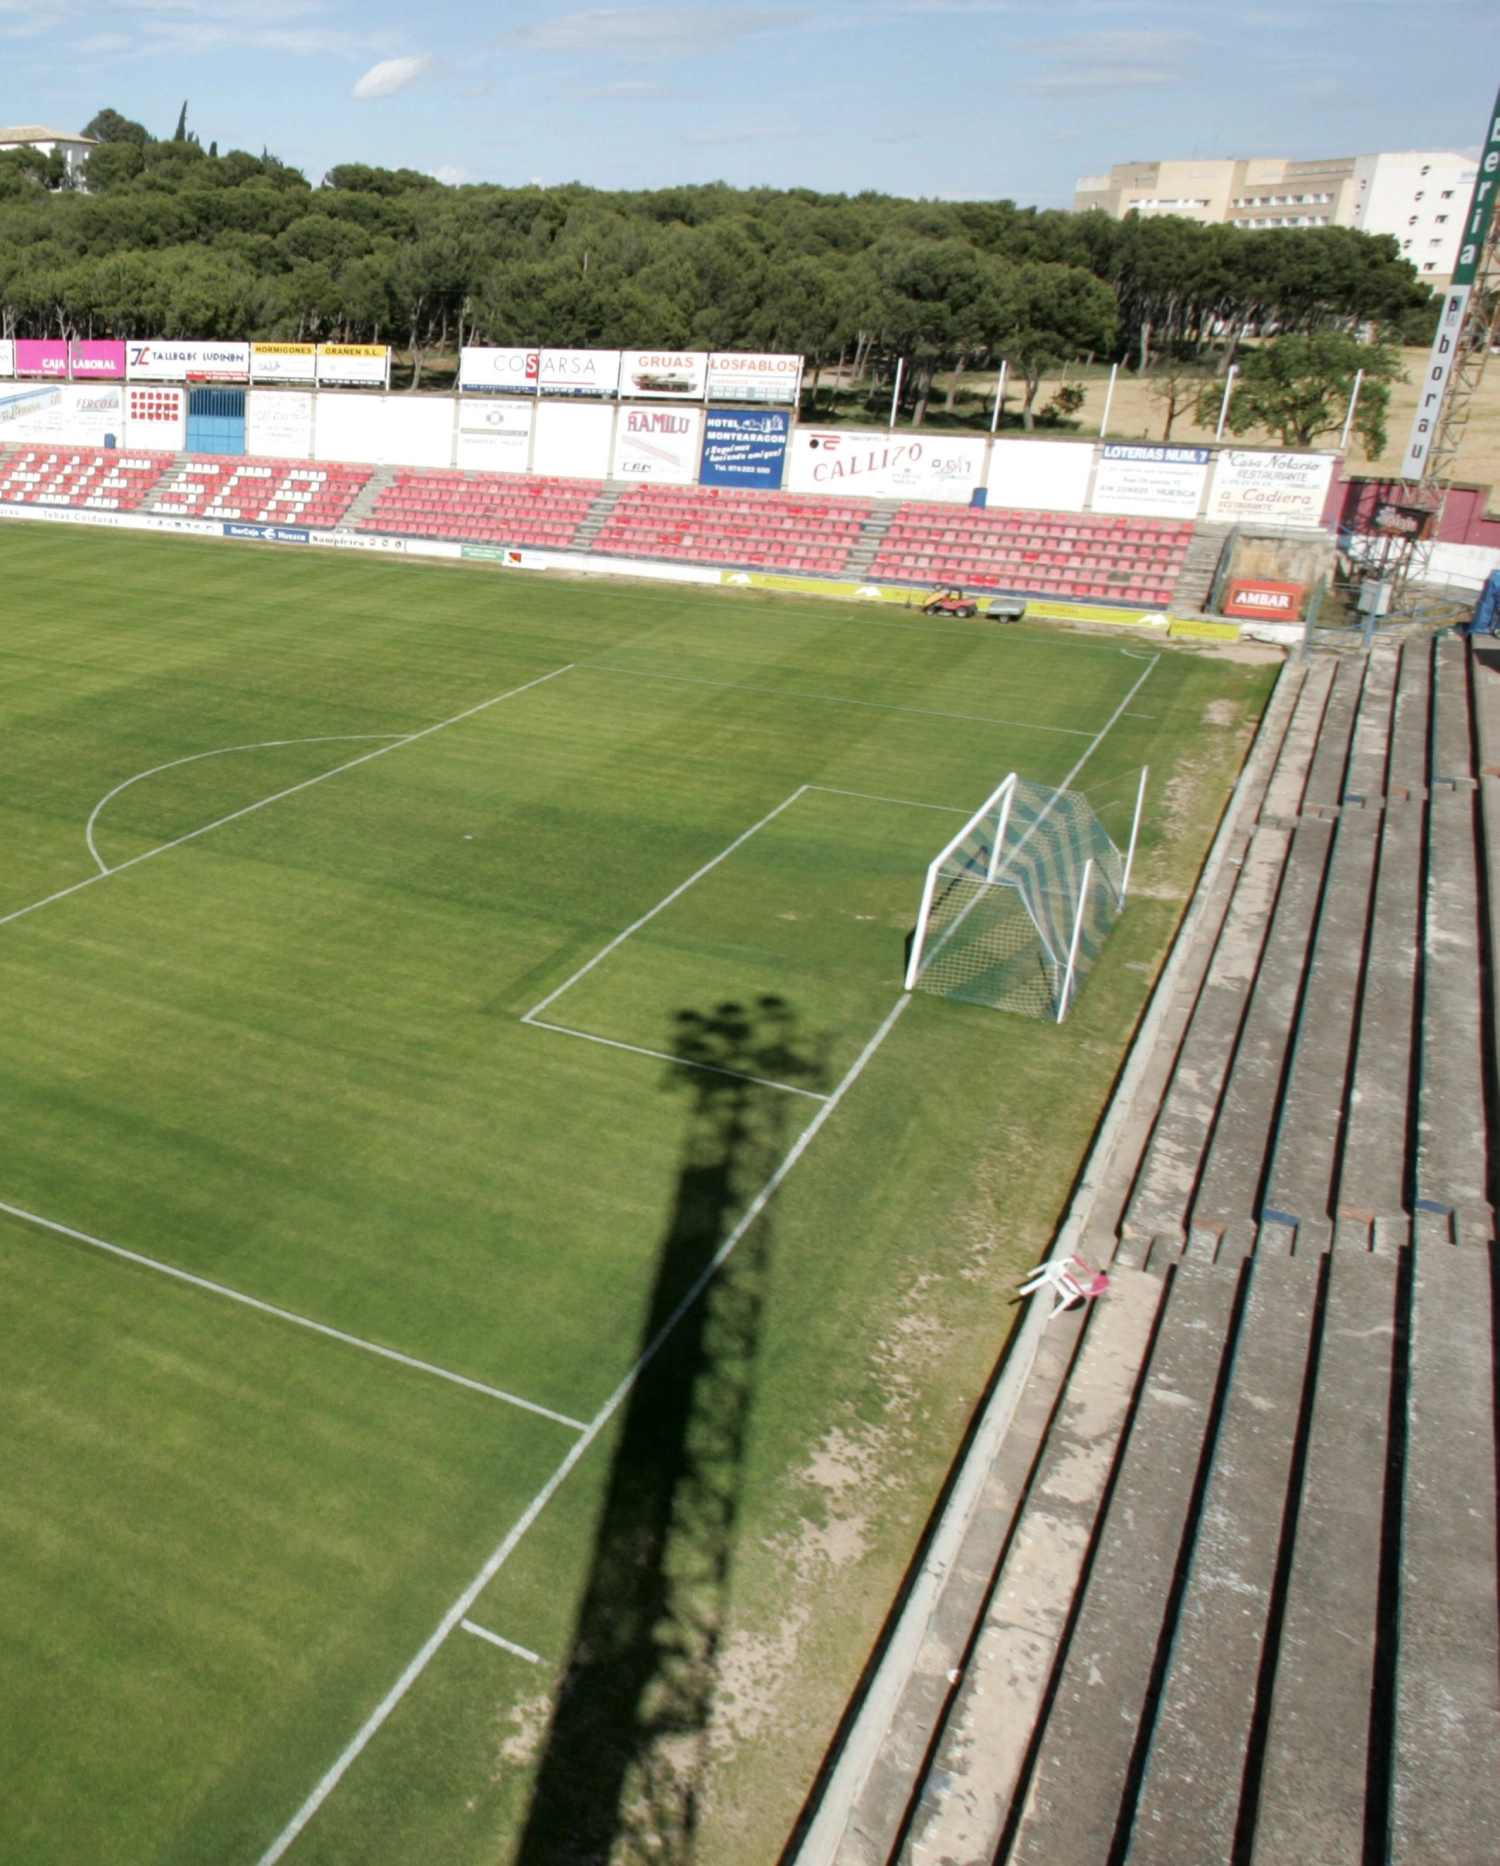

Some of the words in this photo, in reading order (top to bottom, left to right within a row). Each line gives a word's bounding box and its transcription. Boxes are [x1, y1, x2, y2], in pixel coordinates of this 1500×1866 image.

[255, 346, 312, 354] HORMIGONES
[42, 358, 66, 370] CAJA
[73, 359, 116, 370] LABORAL
[638, 355, 695, 368] GRUAS
[76, 398, 120, 409] FERCOSA
[708, 418, 739, 428] HOTEL
[707, 431, 786, 443] MONTEARAGON
[1104, 446, 1164, 461] LOTERIAS
[813, 442, 923, 482] CALLIZO
[1230, 453, 1262, 468] Casa
[1236, 469, 1309, 482] RESTAURANTE
[1242, 488, 1311, 505] Cadiera
[43, 509, 70, 521] Tebas
[74, 513, 120, 525] Coiduras
[1235, 590, 1290, 609] AMBAR
